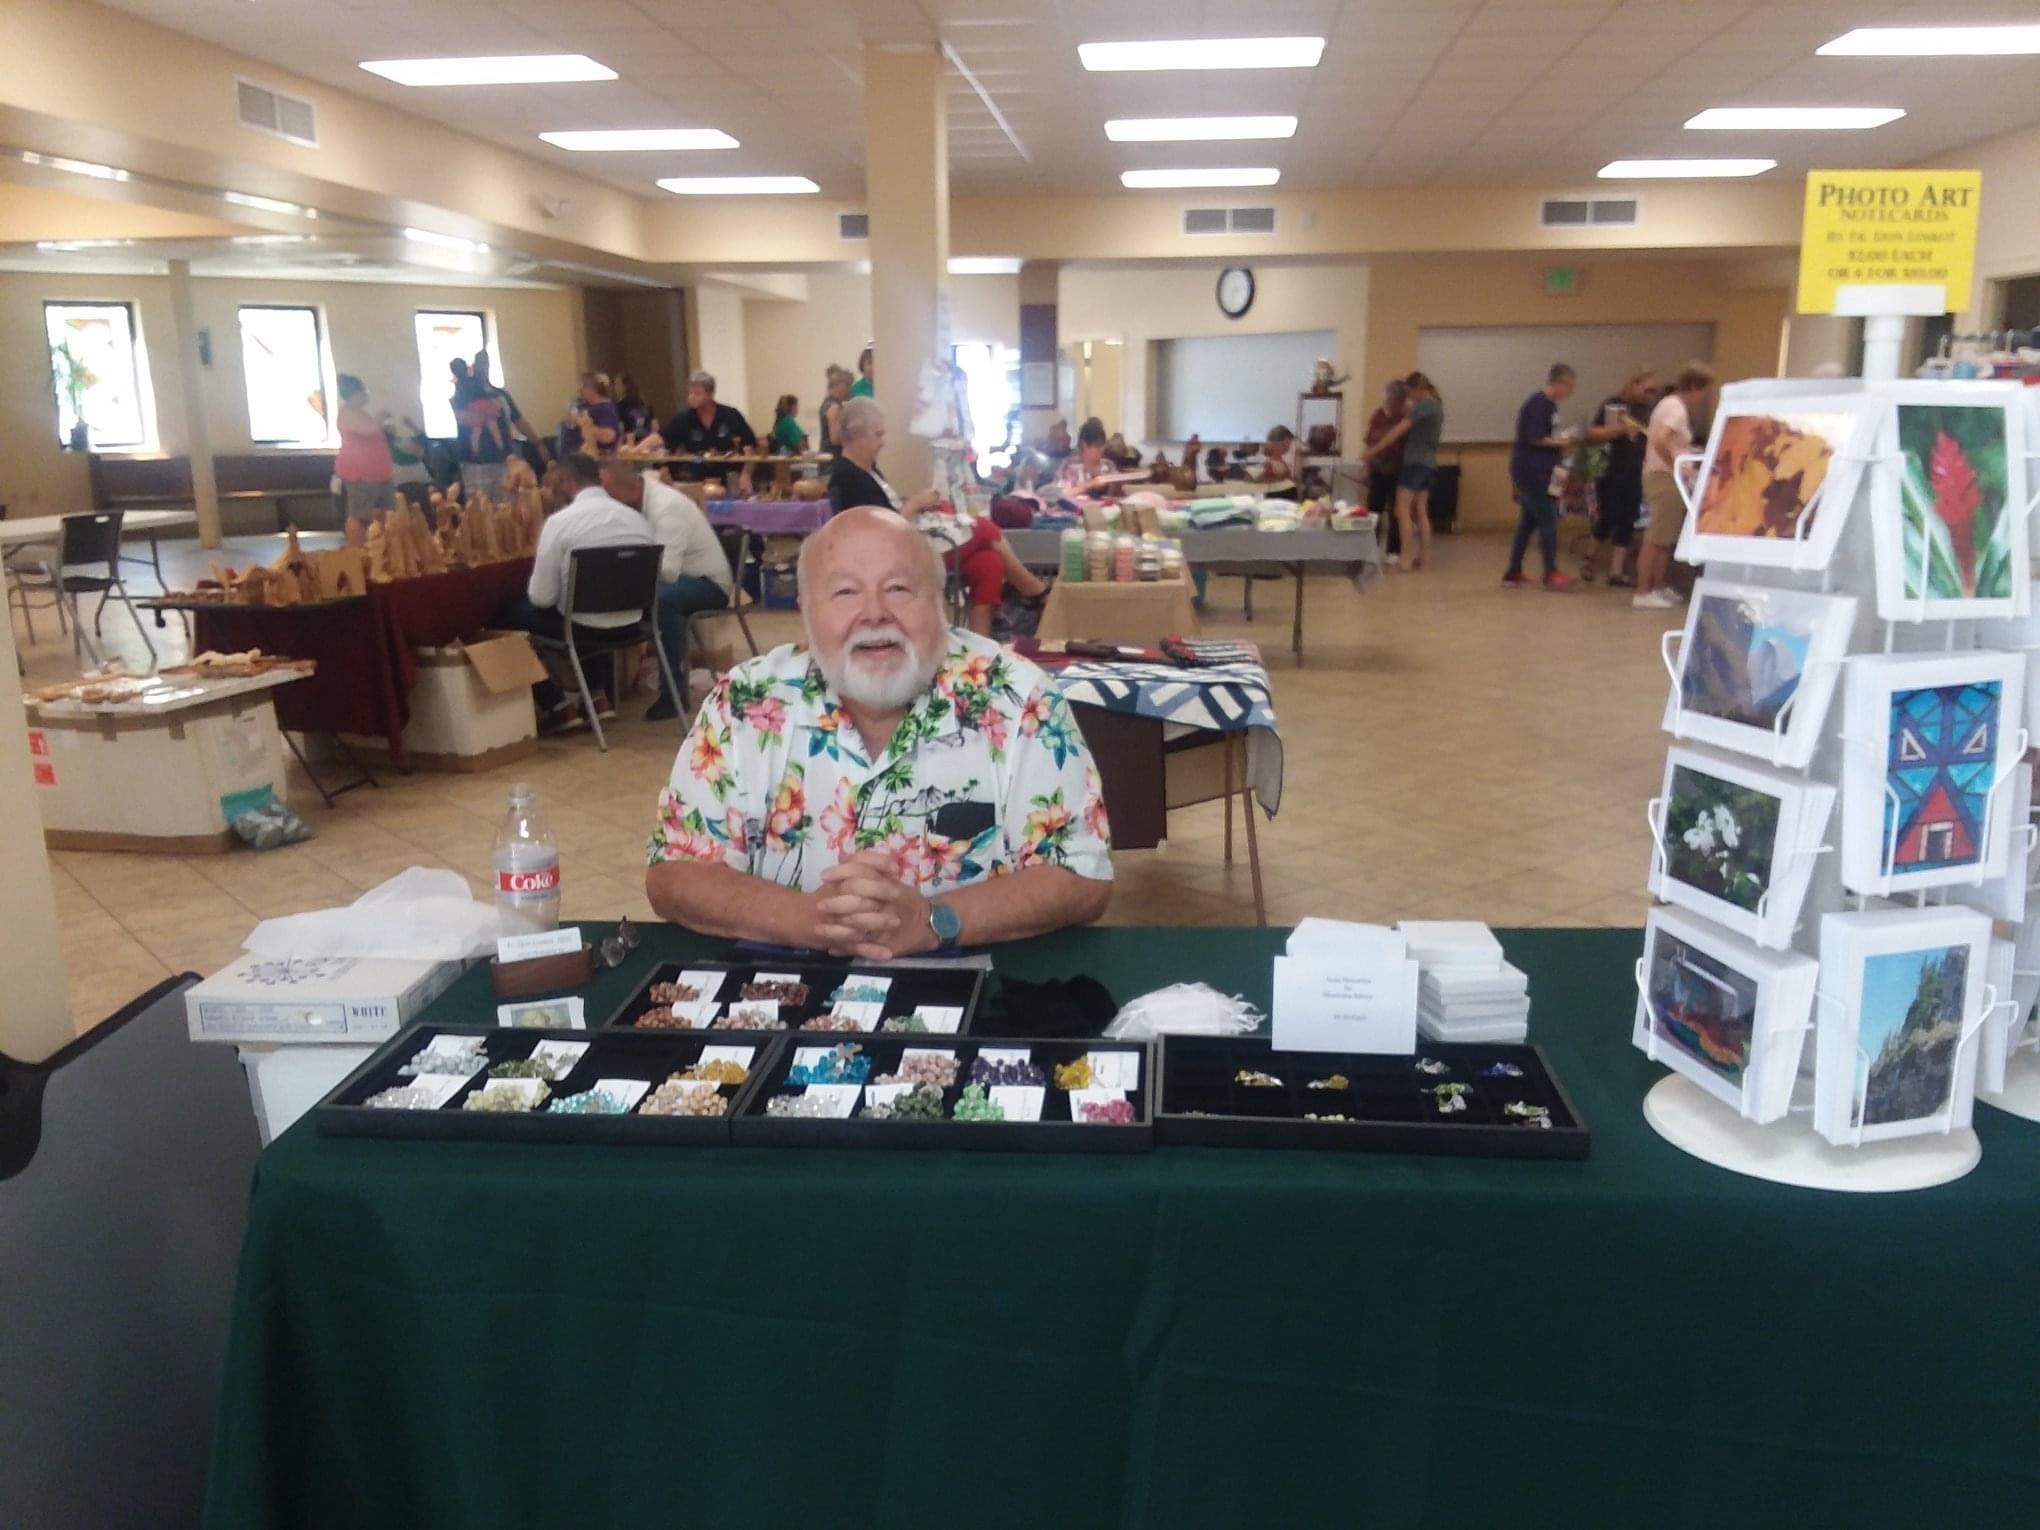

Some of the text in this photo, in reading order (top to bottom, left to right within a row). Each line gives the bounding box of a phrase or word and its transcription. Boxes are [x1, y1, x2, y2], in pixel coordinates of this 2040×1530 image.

[1818, 183, 1974, 208] PHOTO ART
[1839, 208, 1950, 223] NOTECARDS
[510, 872, 554, 891] Coke
